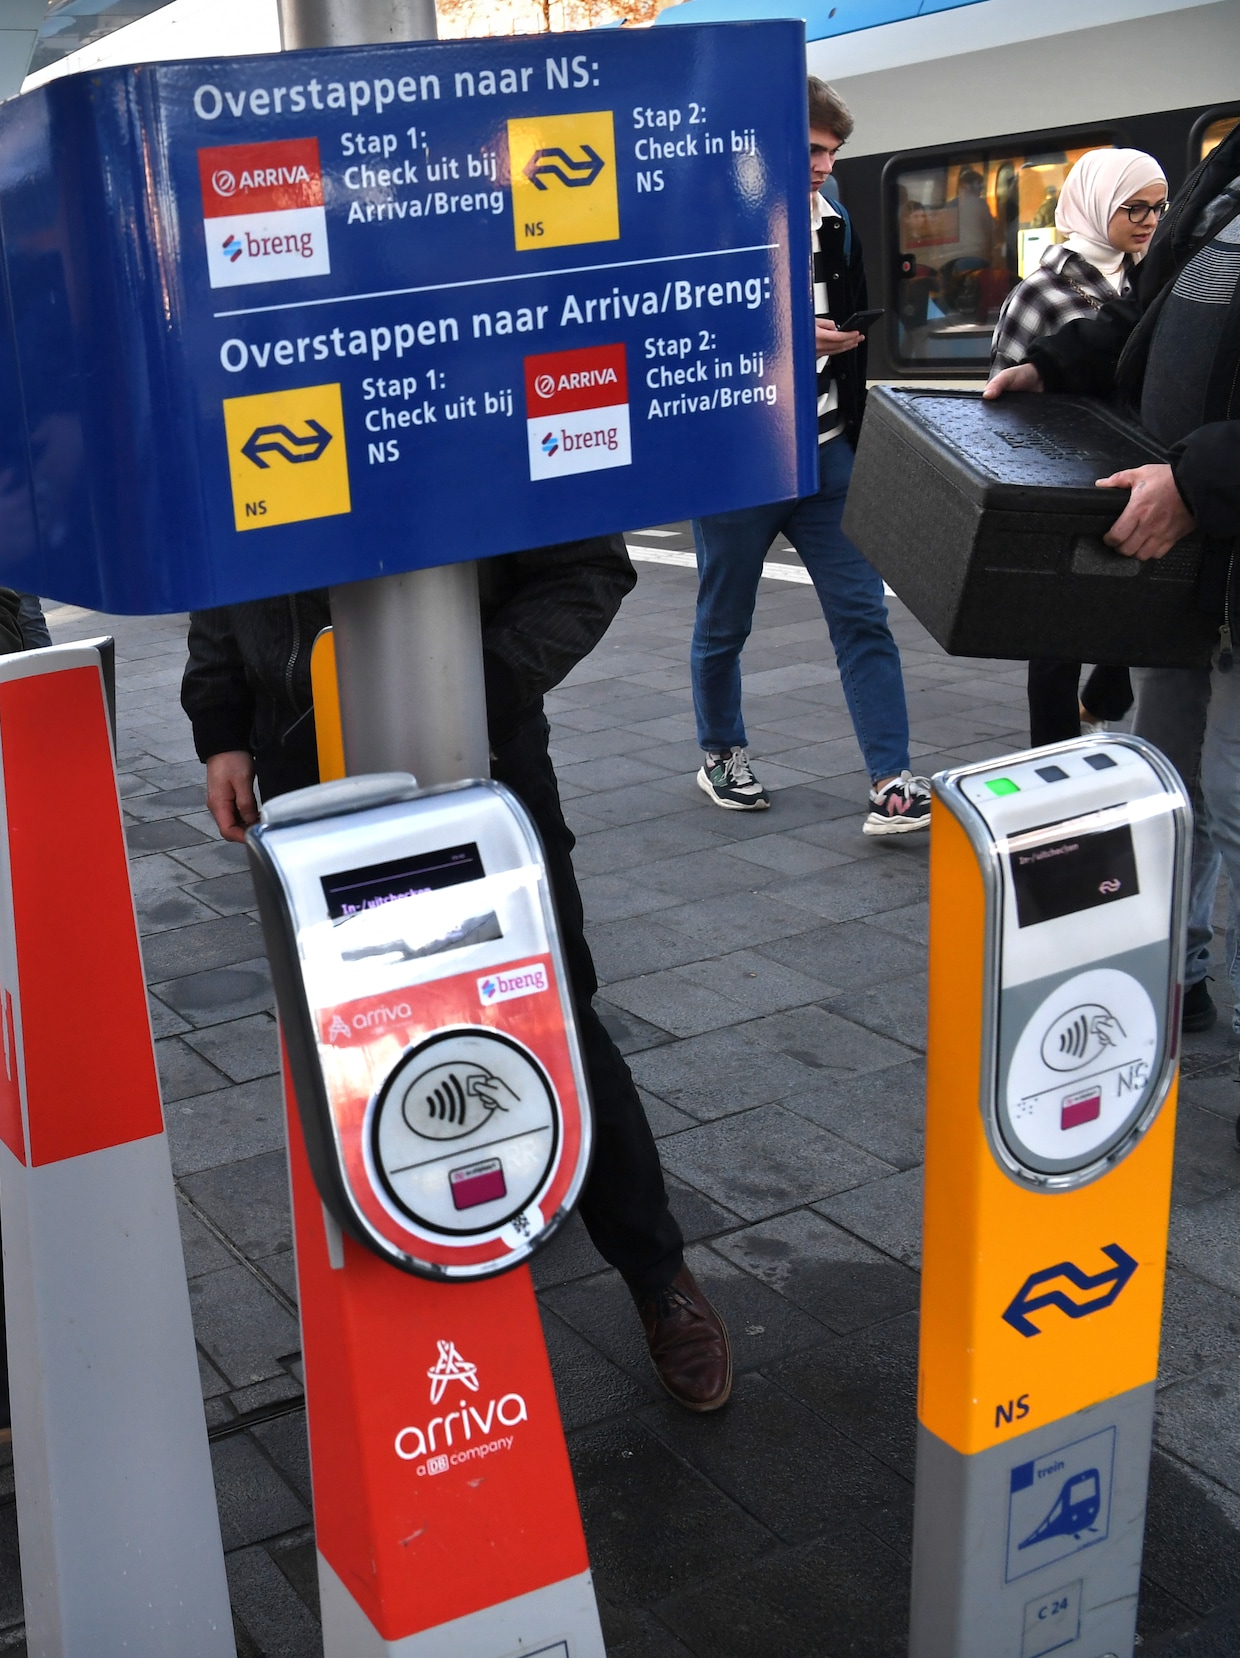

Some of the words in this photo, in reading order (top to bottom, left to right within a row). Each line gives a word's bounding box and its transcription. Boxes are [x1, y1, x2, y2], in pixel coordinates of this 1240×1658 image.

[193, 75, 440, 120] Overstappen
[454, 69, 533, 98] naar
[546, 55, 601, 90] NS:
[633, 106, 681, 132] Stap
[688, 102, 707, 124] 2:
[341, 131, 397, 158] Stap
[407, 126, 427, 149] 1:
[634, 133, 698, 161] Check
[705, 132, 724, 154] in
[731, 130, 757, 157] bij
[239, 165, 310, 189] ARRIVA
[343, 160, 418, 190] Check
[426, 157, 460, 182] uit
[467, 153, 498, 182] bij
[637, 169, 665, 193] NS
[347, 191, 505, 224] Arriva/Breng
[245, 227, 314, 260] breng
[524, 221, 544, 237] NS
[220, 318, 459, 373] Overstappen
[472, 304, 548, 338] naar
[560, 275, 771, 326] Arriva/Breng:
[645, 336, 692, 359] Stap
[699, 330, 717, 351] 2:
[362, 376, 417, 400] Stap
[426, 369, 447, 390] 1:
[557, 368, 618, 391] ARRIVA
[646, 360, 708, 389] Check
[714, 358, 733, 379] in
[740, 353, 765, 378] bij
[365, 401, 437, 432] Check
[445, 396, 477, 420] uit
[484, 391, 514, 418] bij
[648, 383, 778, 420] Arriva/Breng
[368, 440, 400, 465] NS
[560, 423, 618, 453] breng
[245, 501, 267, 517] NS
[496, 970, 544, 994] breng
[352, 1002, 412, 1030] arriva
[394, 1392, 528, 1460] arriva
[994, 1393, 1030, 1428] NS
[416, 1464, 427, 1477] a
[427, 1454, 449, 1475] DB
[450, 1435, 514, 1466] company
[1037, 1459, 1065, 1480] trein
[1038, 1605, 1048, 1621] C
[1051, 1597, 1068, 1617] 24
